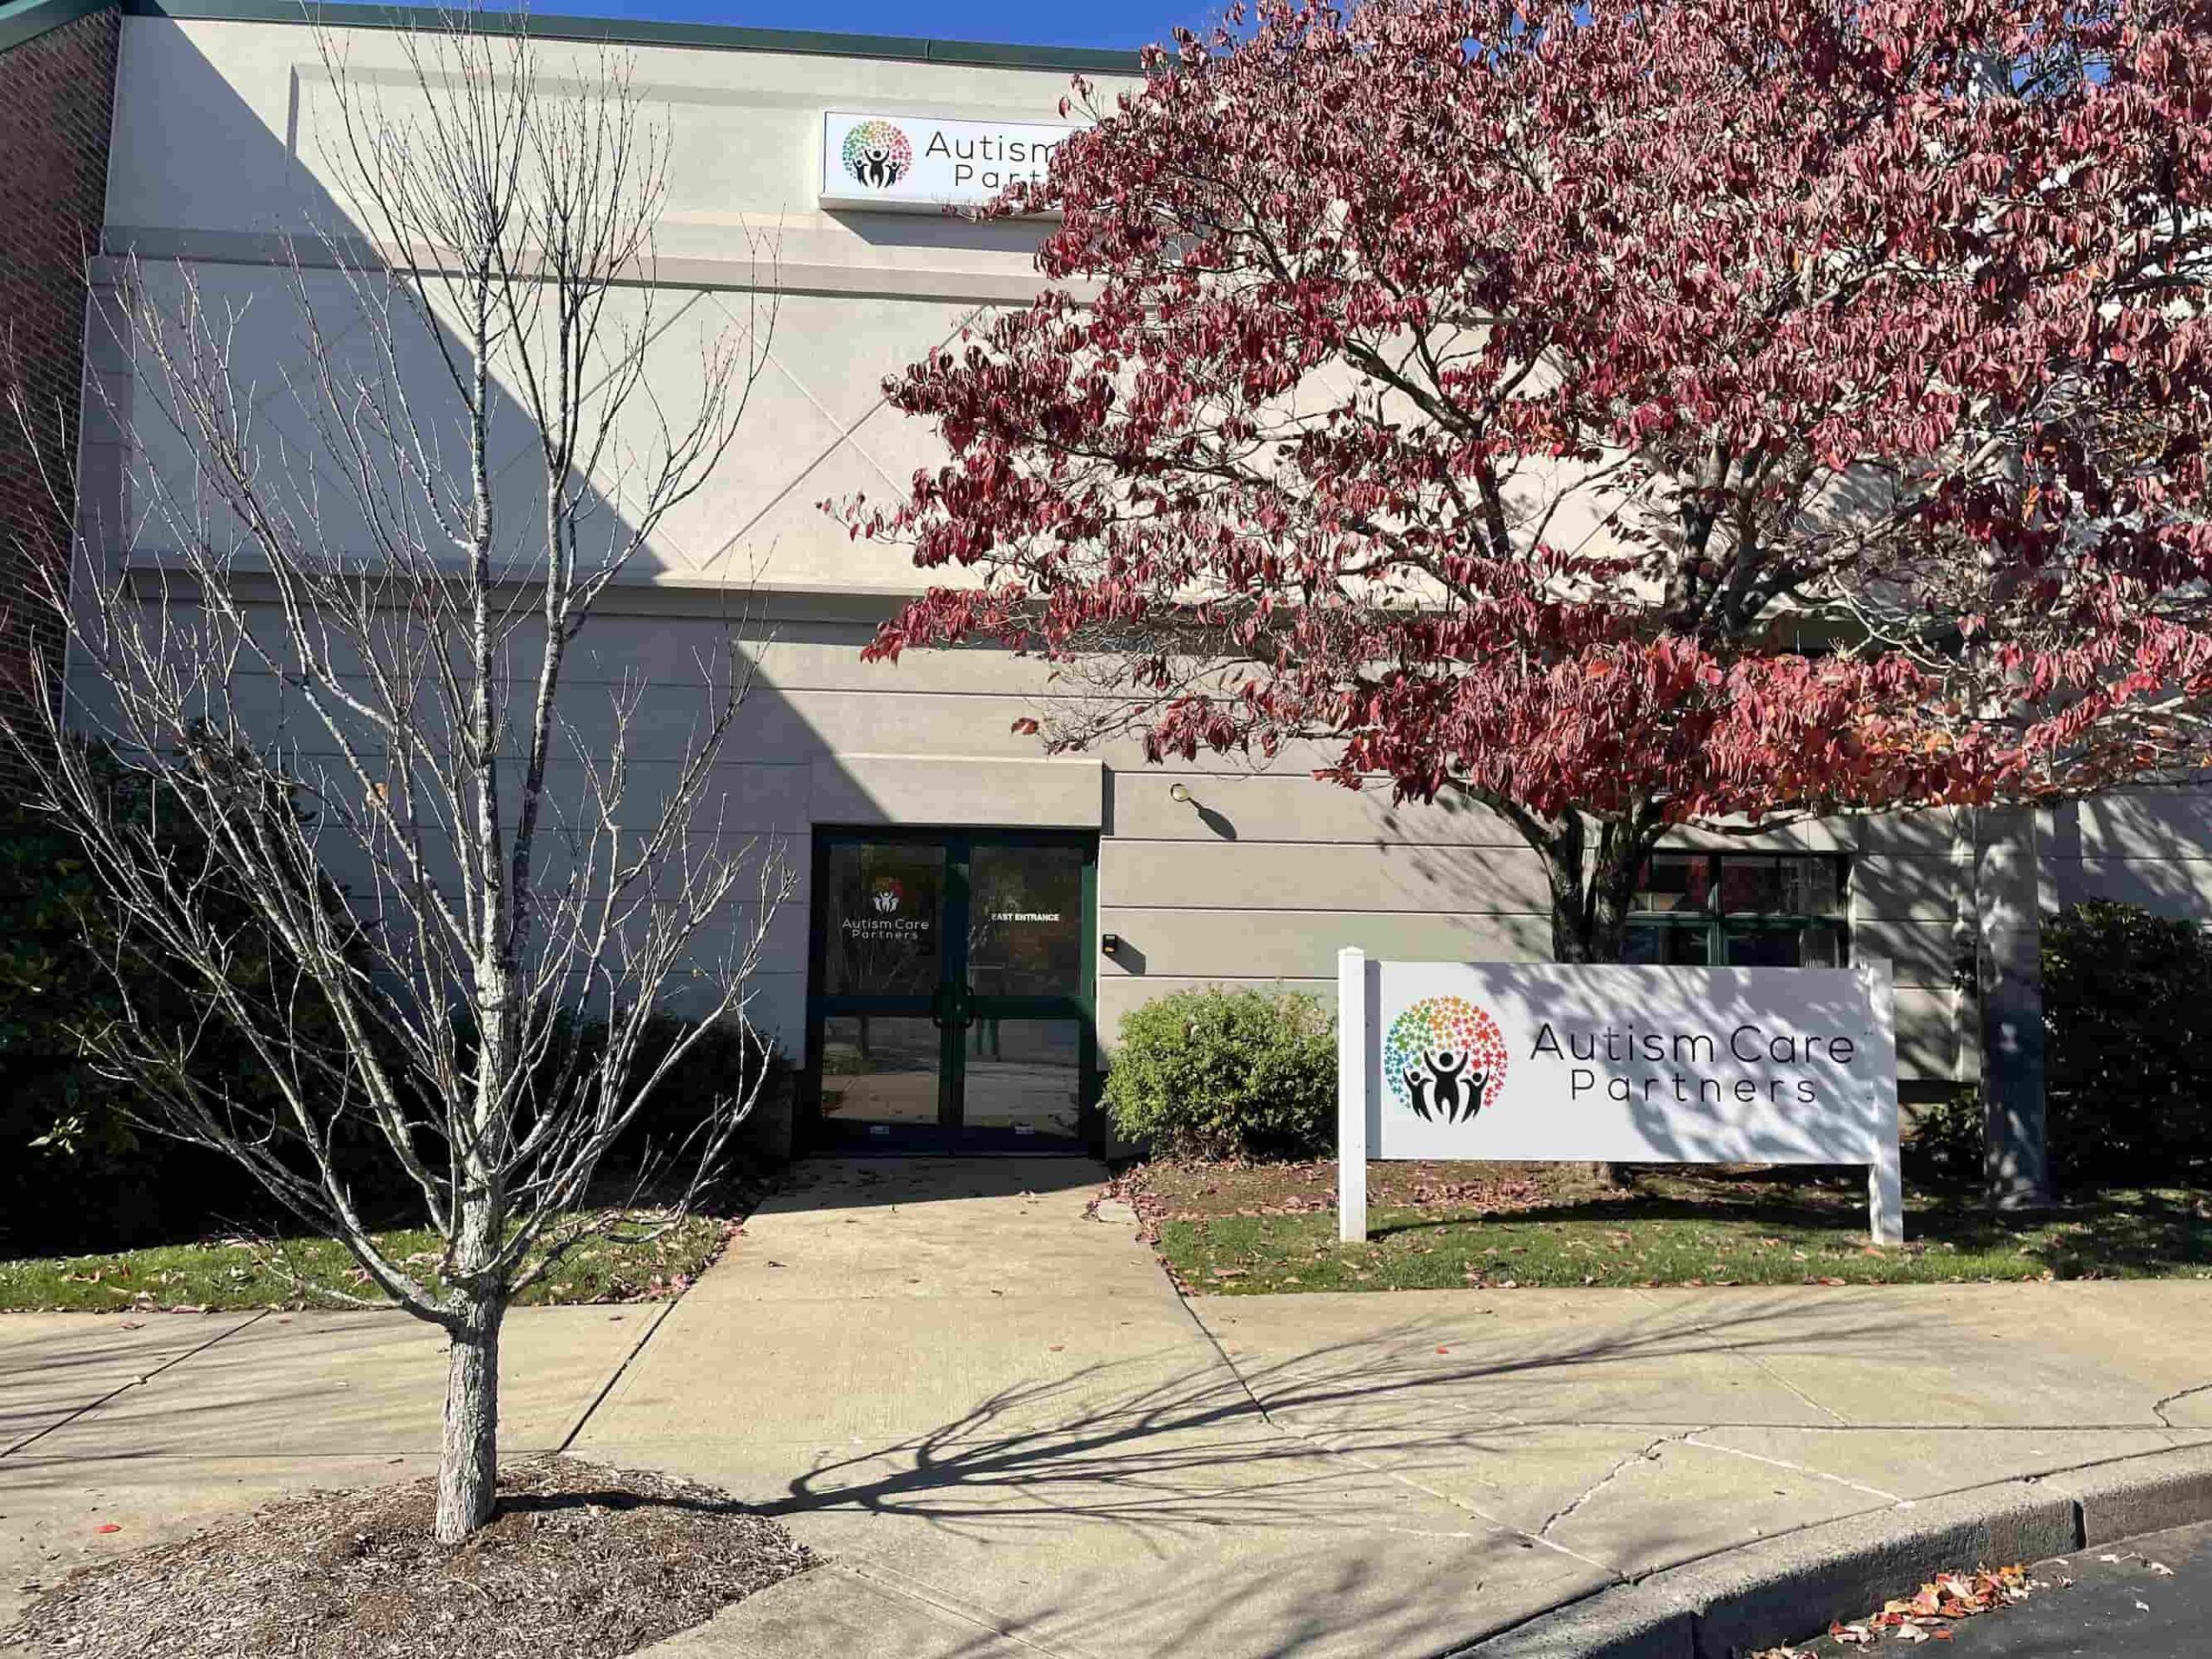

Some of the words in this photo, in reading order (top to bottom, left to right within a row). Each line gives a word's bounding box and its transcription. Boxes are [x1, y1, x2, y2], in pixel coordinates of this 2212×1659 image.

[925, 131, 1058, 162] Autism
[956, 164, 1042, 188] Part
[842, 918, 892, 929] Autism
[895, 918, 929, 930] Care
[991, 912, 1013, 922] EAST
[1014, 912, 1059, 922] ENTRANCE
[852, 929, 918, 939] Partners
[1530, 1023, 1713, 1063] Autism
[1731, 1025, 1853, 1064] Care
[1571, 1069, 1815, 1103] Partners
